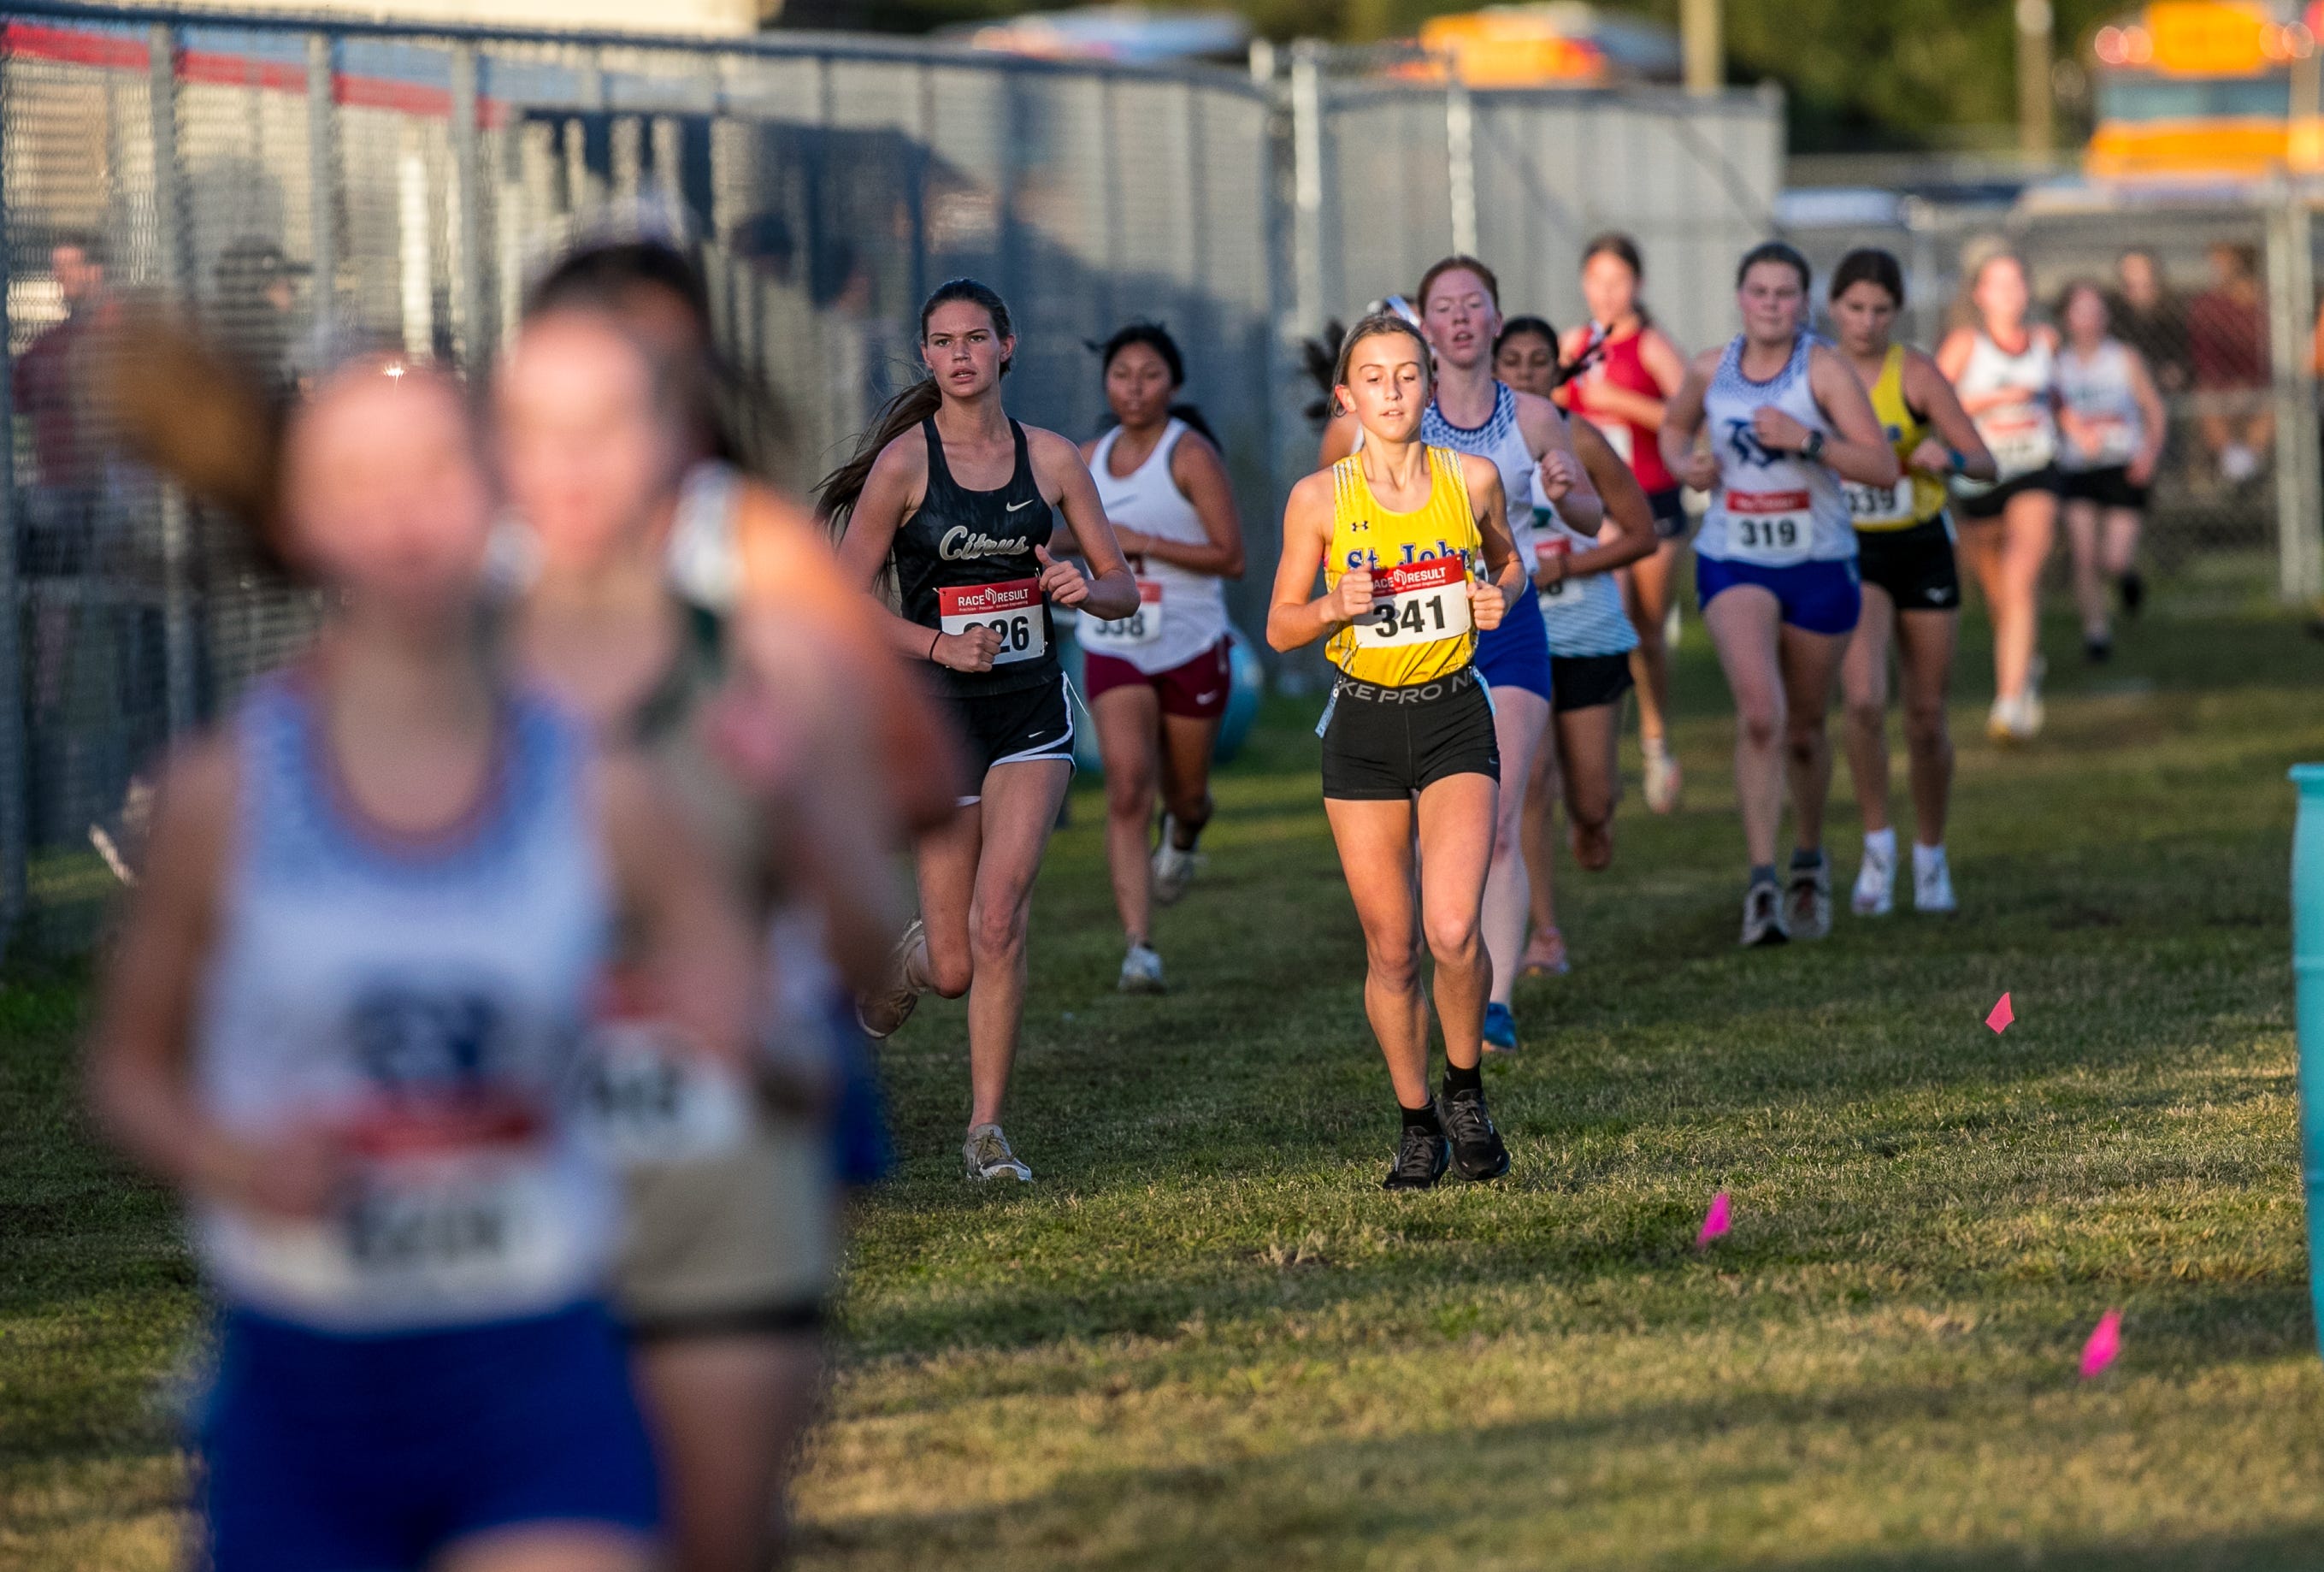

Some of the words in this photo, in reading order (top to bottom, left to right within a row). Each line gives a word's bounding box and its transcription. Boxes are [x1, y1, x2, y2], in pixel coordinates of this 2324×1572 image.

[940, 525, 1029, 560] Citrus
[1740, 519, 1796, 547] 319
[1372, 576, 1395, 589] ACE
[1407, 567, 1446, 583] RESULT
[958, 594, 985, 606] RACE
[997, 588, 1029, 603] RESULT
[1373, 595, 1446, 638] 341
[1377, 683, 1442, 705] PRO
